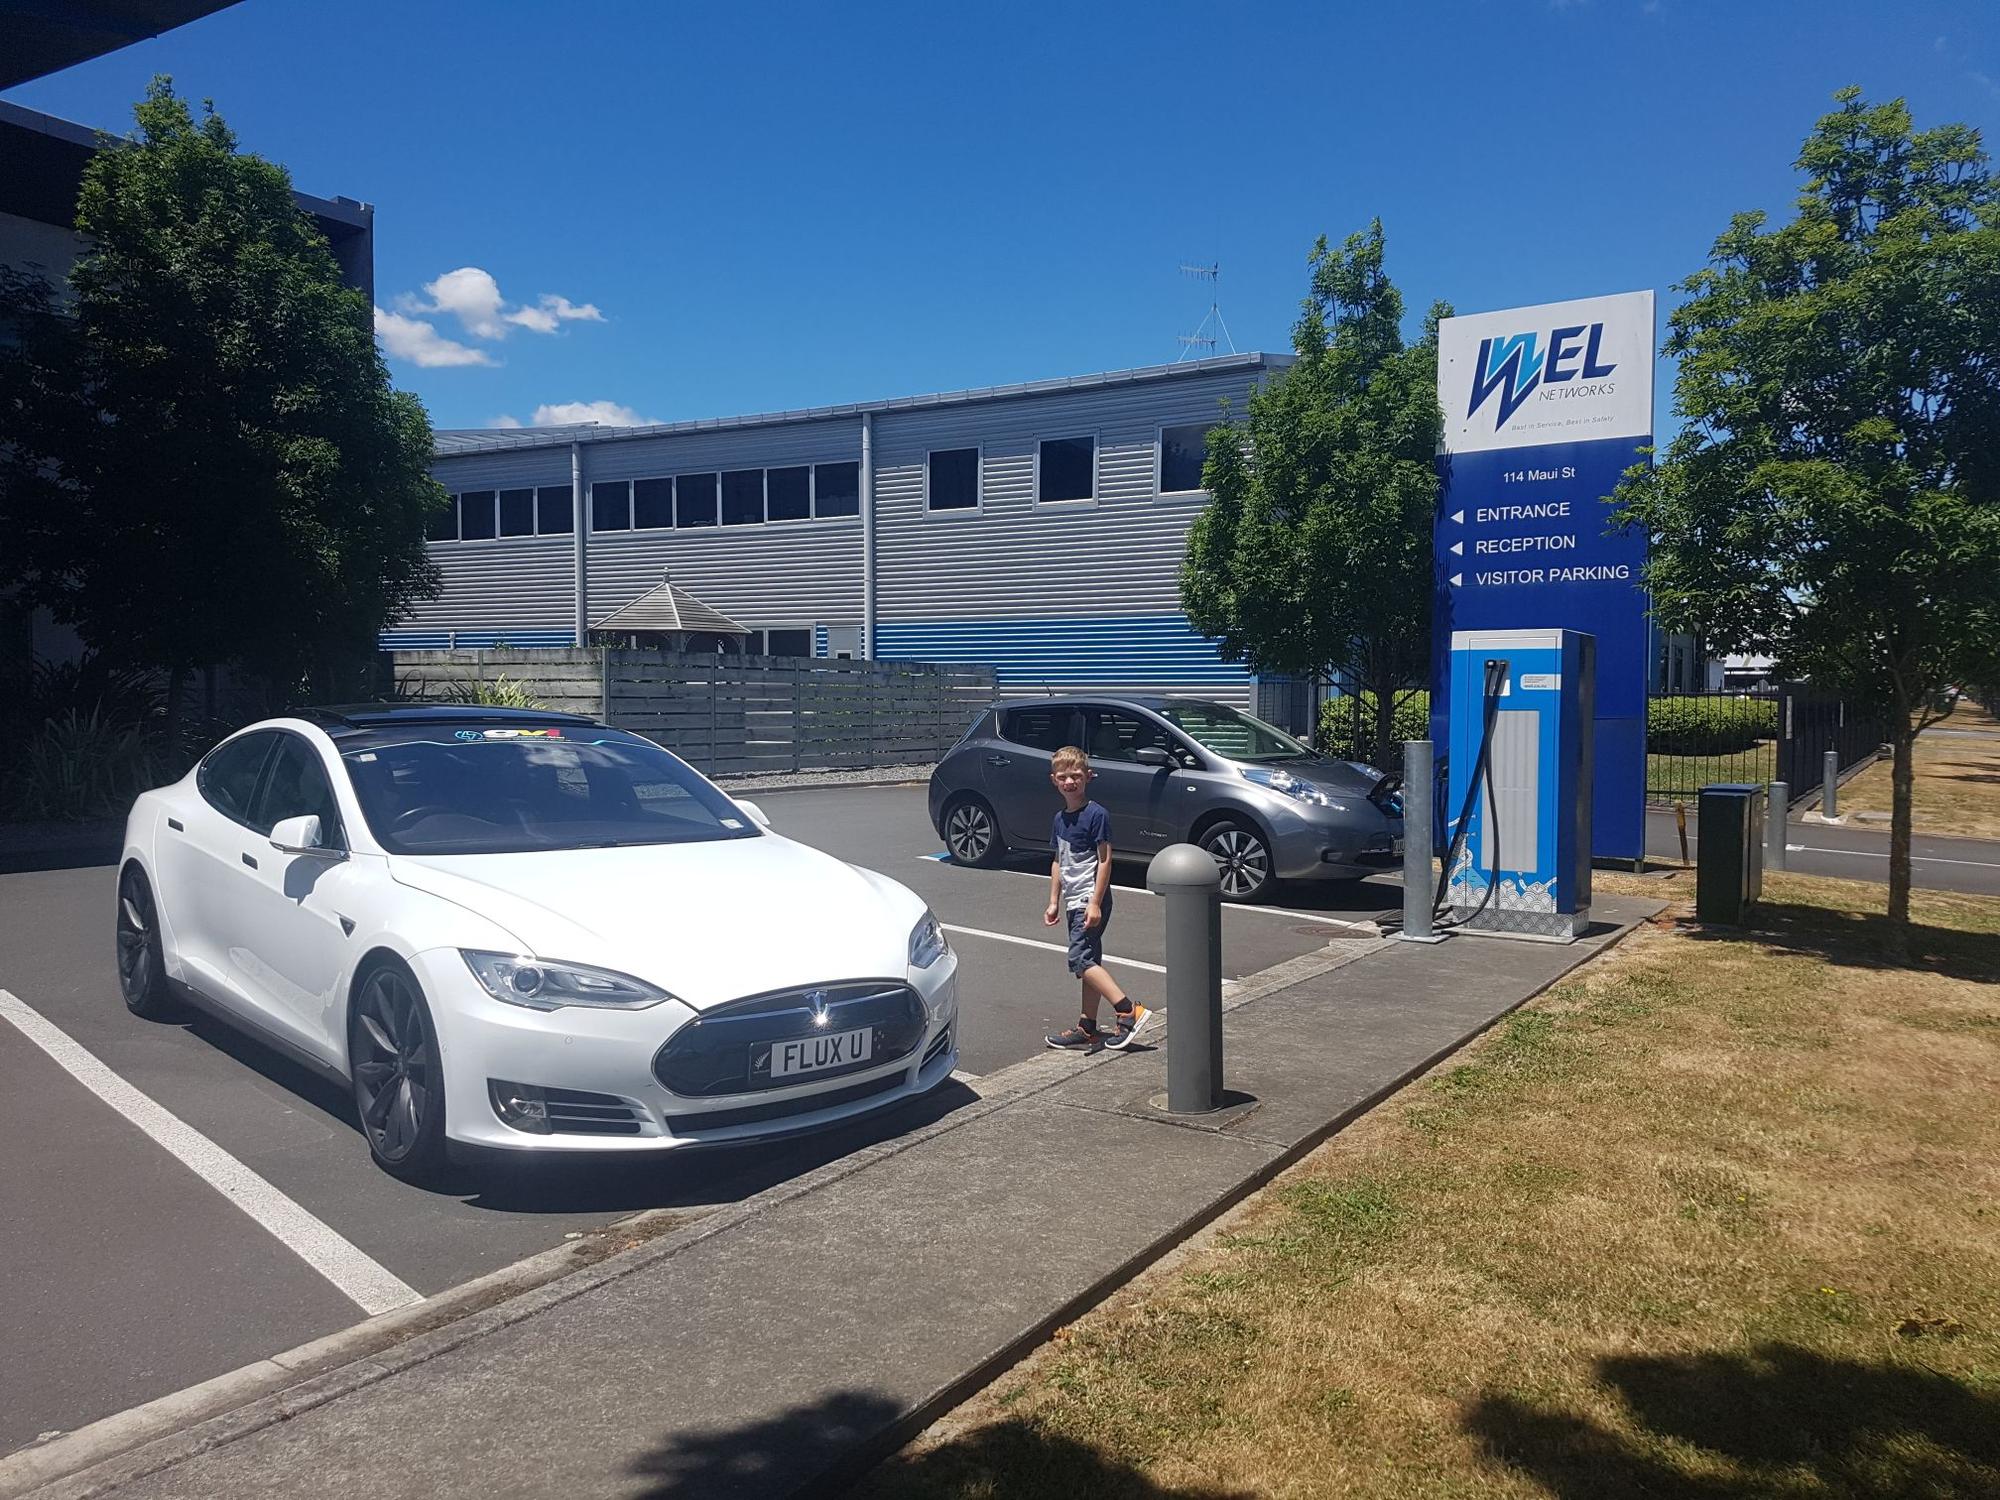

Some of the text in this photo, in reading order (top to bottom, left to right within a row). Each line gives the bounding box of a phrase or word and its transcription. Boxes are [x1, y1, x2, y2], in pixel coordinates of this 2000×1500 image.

[1466, 322, 1618, 433] WEL
[1539, 383, 1615, 402] NETWORKS
[1503, 466, 1576, 483] 114 Maui St
[1476, 502, 1571, 522] ENTRANCE
[1476, 535, 1576, 554] RECEPTION
[1476, 564, 1629, 585] VISITOR PARKING
[784, 1032, 863, 1072] FLUX U
